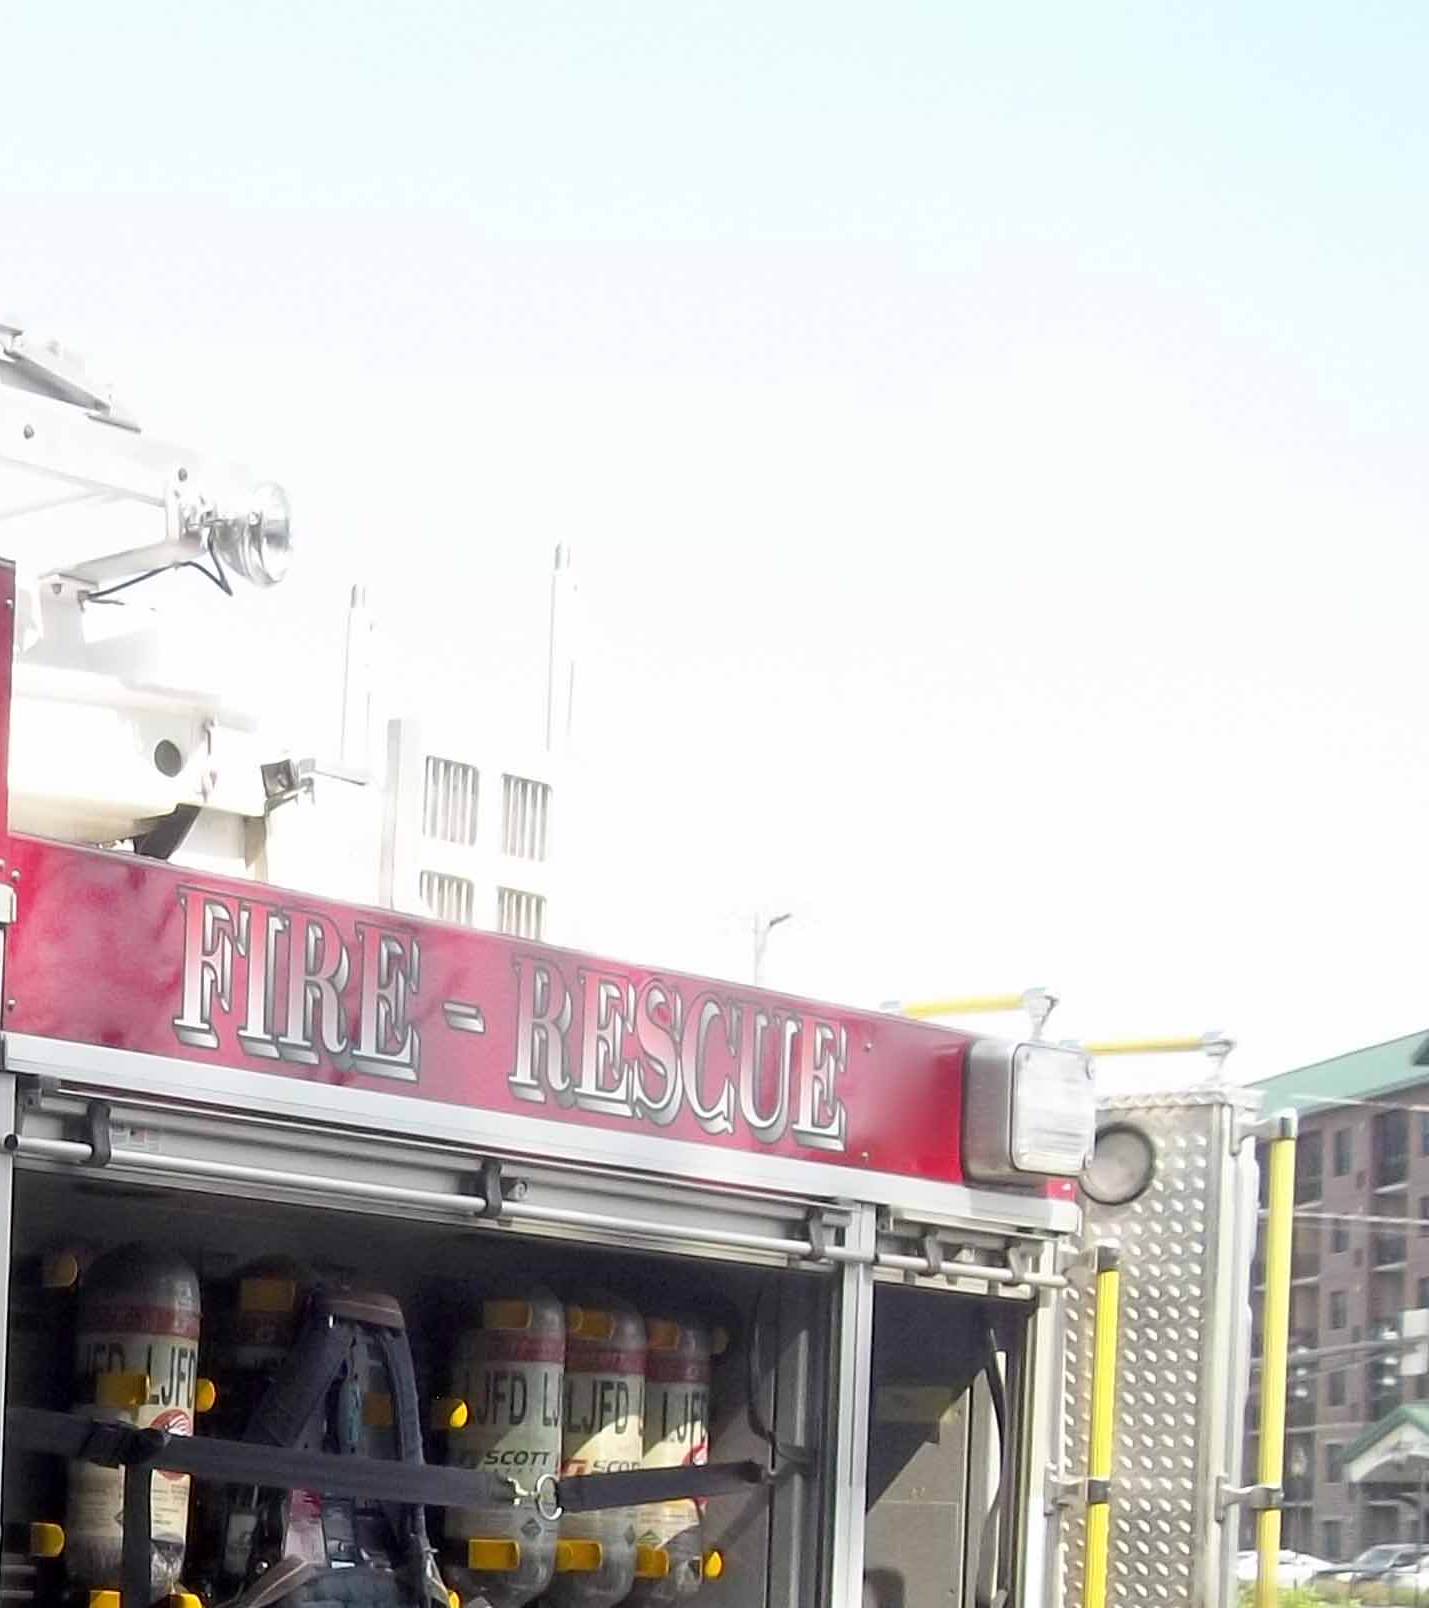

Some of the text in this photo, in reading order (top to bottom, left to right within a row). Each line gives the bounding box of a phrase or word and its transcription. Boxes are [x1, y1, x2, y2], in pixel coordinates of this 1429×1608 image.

[172, 885, 421, 1082] FIRE
[509, 953, 848, 1152] RESCUE
[564, 1377, 629, 1435] LJFD
[484, 1450, 550, 1466] SCOTT
